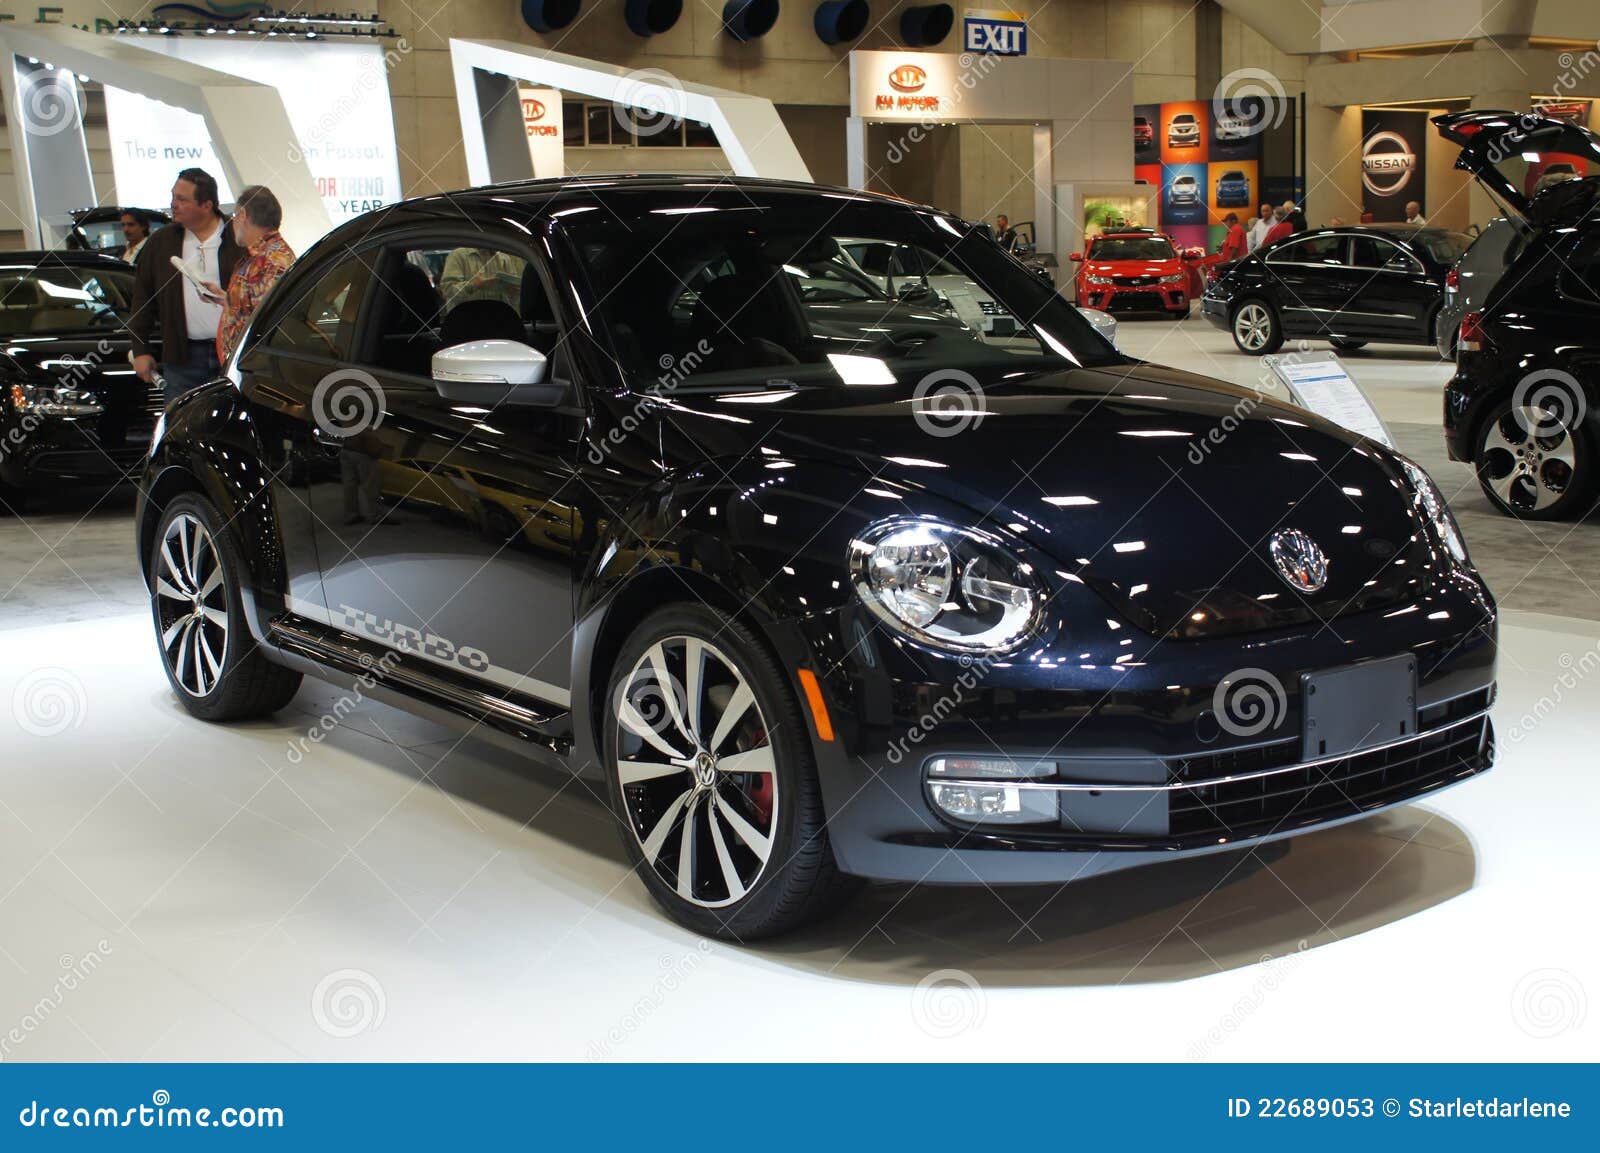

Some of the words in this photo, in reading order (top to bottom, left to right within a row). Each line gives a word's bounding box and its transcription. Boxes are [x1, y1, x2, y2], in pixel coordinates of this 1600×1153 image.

[968, 23, 1024, 52] EXIT
[876, 95, 895, 108] KIA
[897, 95, 940, 109] MOTORS
[124, 140, 157, 159] The
[164, 147, 202, 159] new
[1362, 158, 1410, 169] NISSAN
[338, 602, 490, 673] TURBO
